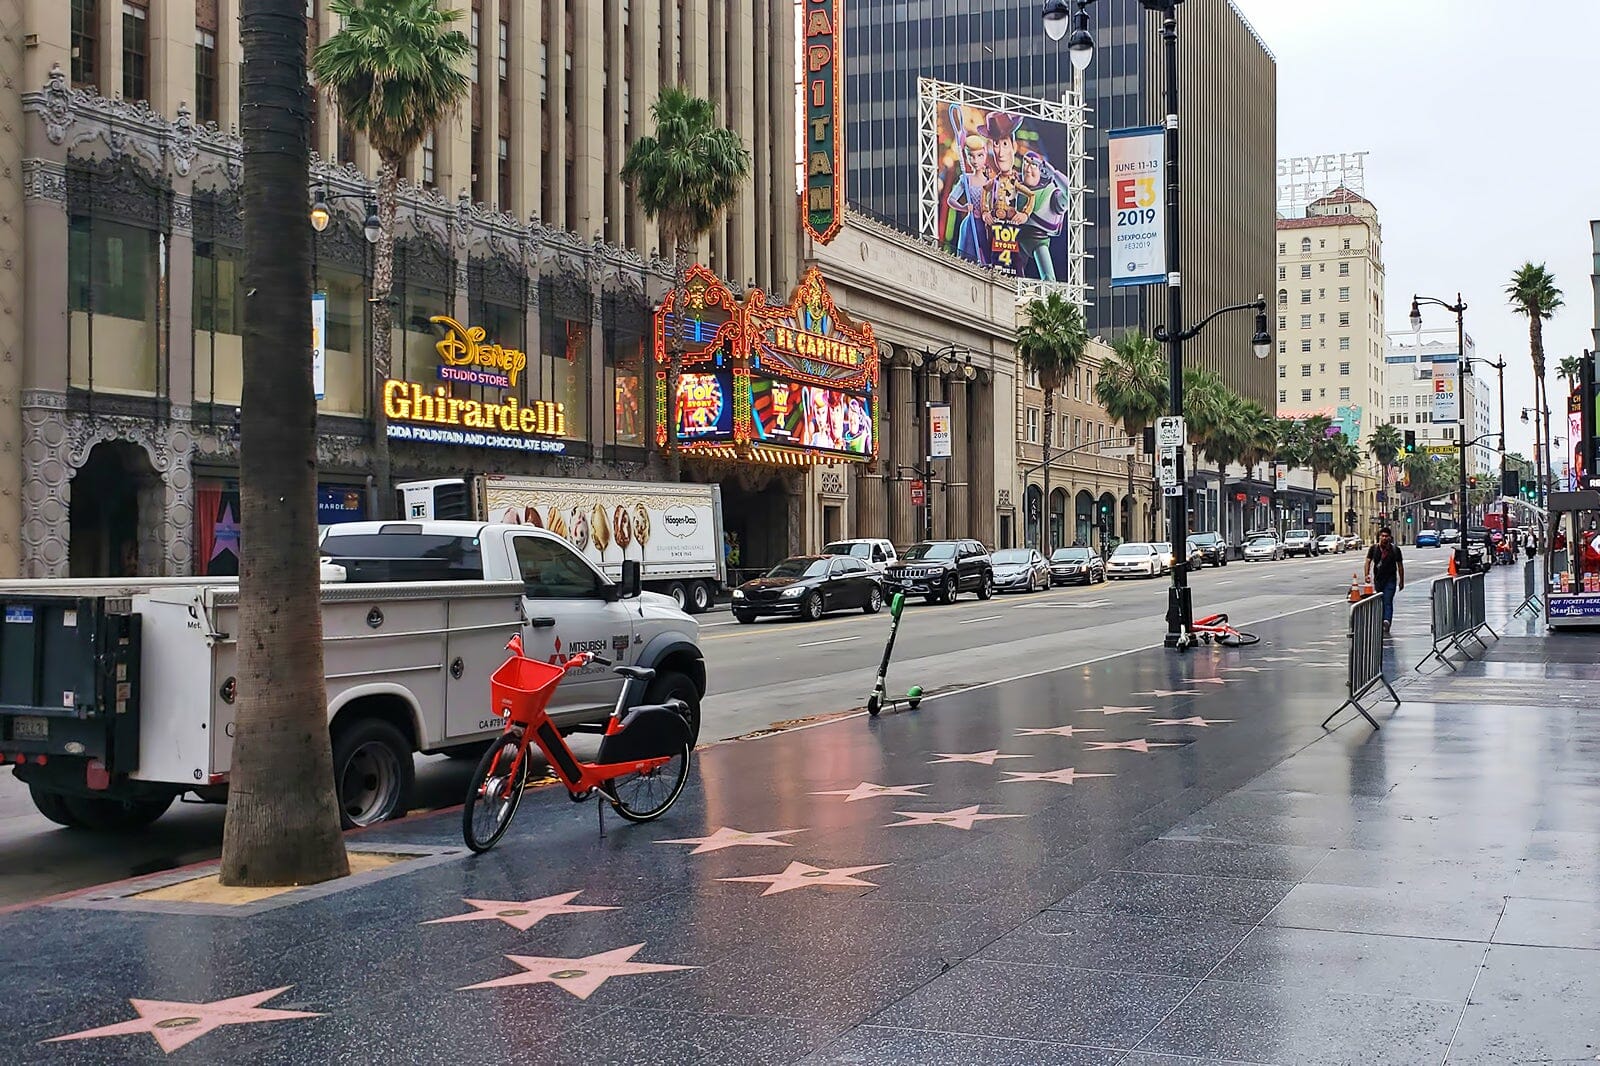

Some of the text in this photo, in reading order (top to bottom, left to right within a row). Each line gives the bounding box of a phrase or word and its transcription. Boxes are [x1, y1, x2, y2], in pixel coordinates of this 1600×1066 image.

[807, 0, 832, 211] APITAN
[1115, 160, 1158, 173] JUNE 11-13
[1117, 177, 1156, 210] E3
[1117, 208, 1156, 227] 2019
[992, 225, 1020, 242] TOY
[1117, 232, 1157, 242] E3EXPO.COM
[994, 241, 1017, 250] STORY
[1124, 242, 1151, 250] #E32019
[998, 250, 1011, 265] 4
[430, 315, 526, 387] Disney
[777, 327, 858, 365] EL CAPITAN
[442, 367, 508, 387] STUDIO STORE
[684, 383, 715, 400] TOY
[1435, 379, 1454, 393] E3
[772, 388, 789, 405] TOY
[1435, 392, 1454, 400] 2019
[384, 379, 567, 436] Ghirardelli
[692, 407, 706, 424] 4
[412, 427, 464, 444] FOUNTAIN
[463, 432, 486, 446] AND
[486, 435, 541, 451] CHOCOLATE
[541, 440, 566, 452] SHOP
[1550, 604, 1584, 616] Starline
[569, 640, 607, 653] MITSUBISHI
[479, 720, 488, 729] CA
